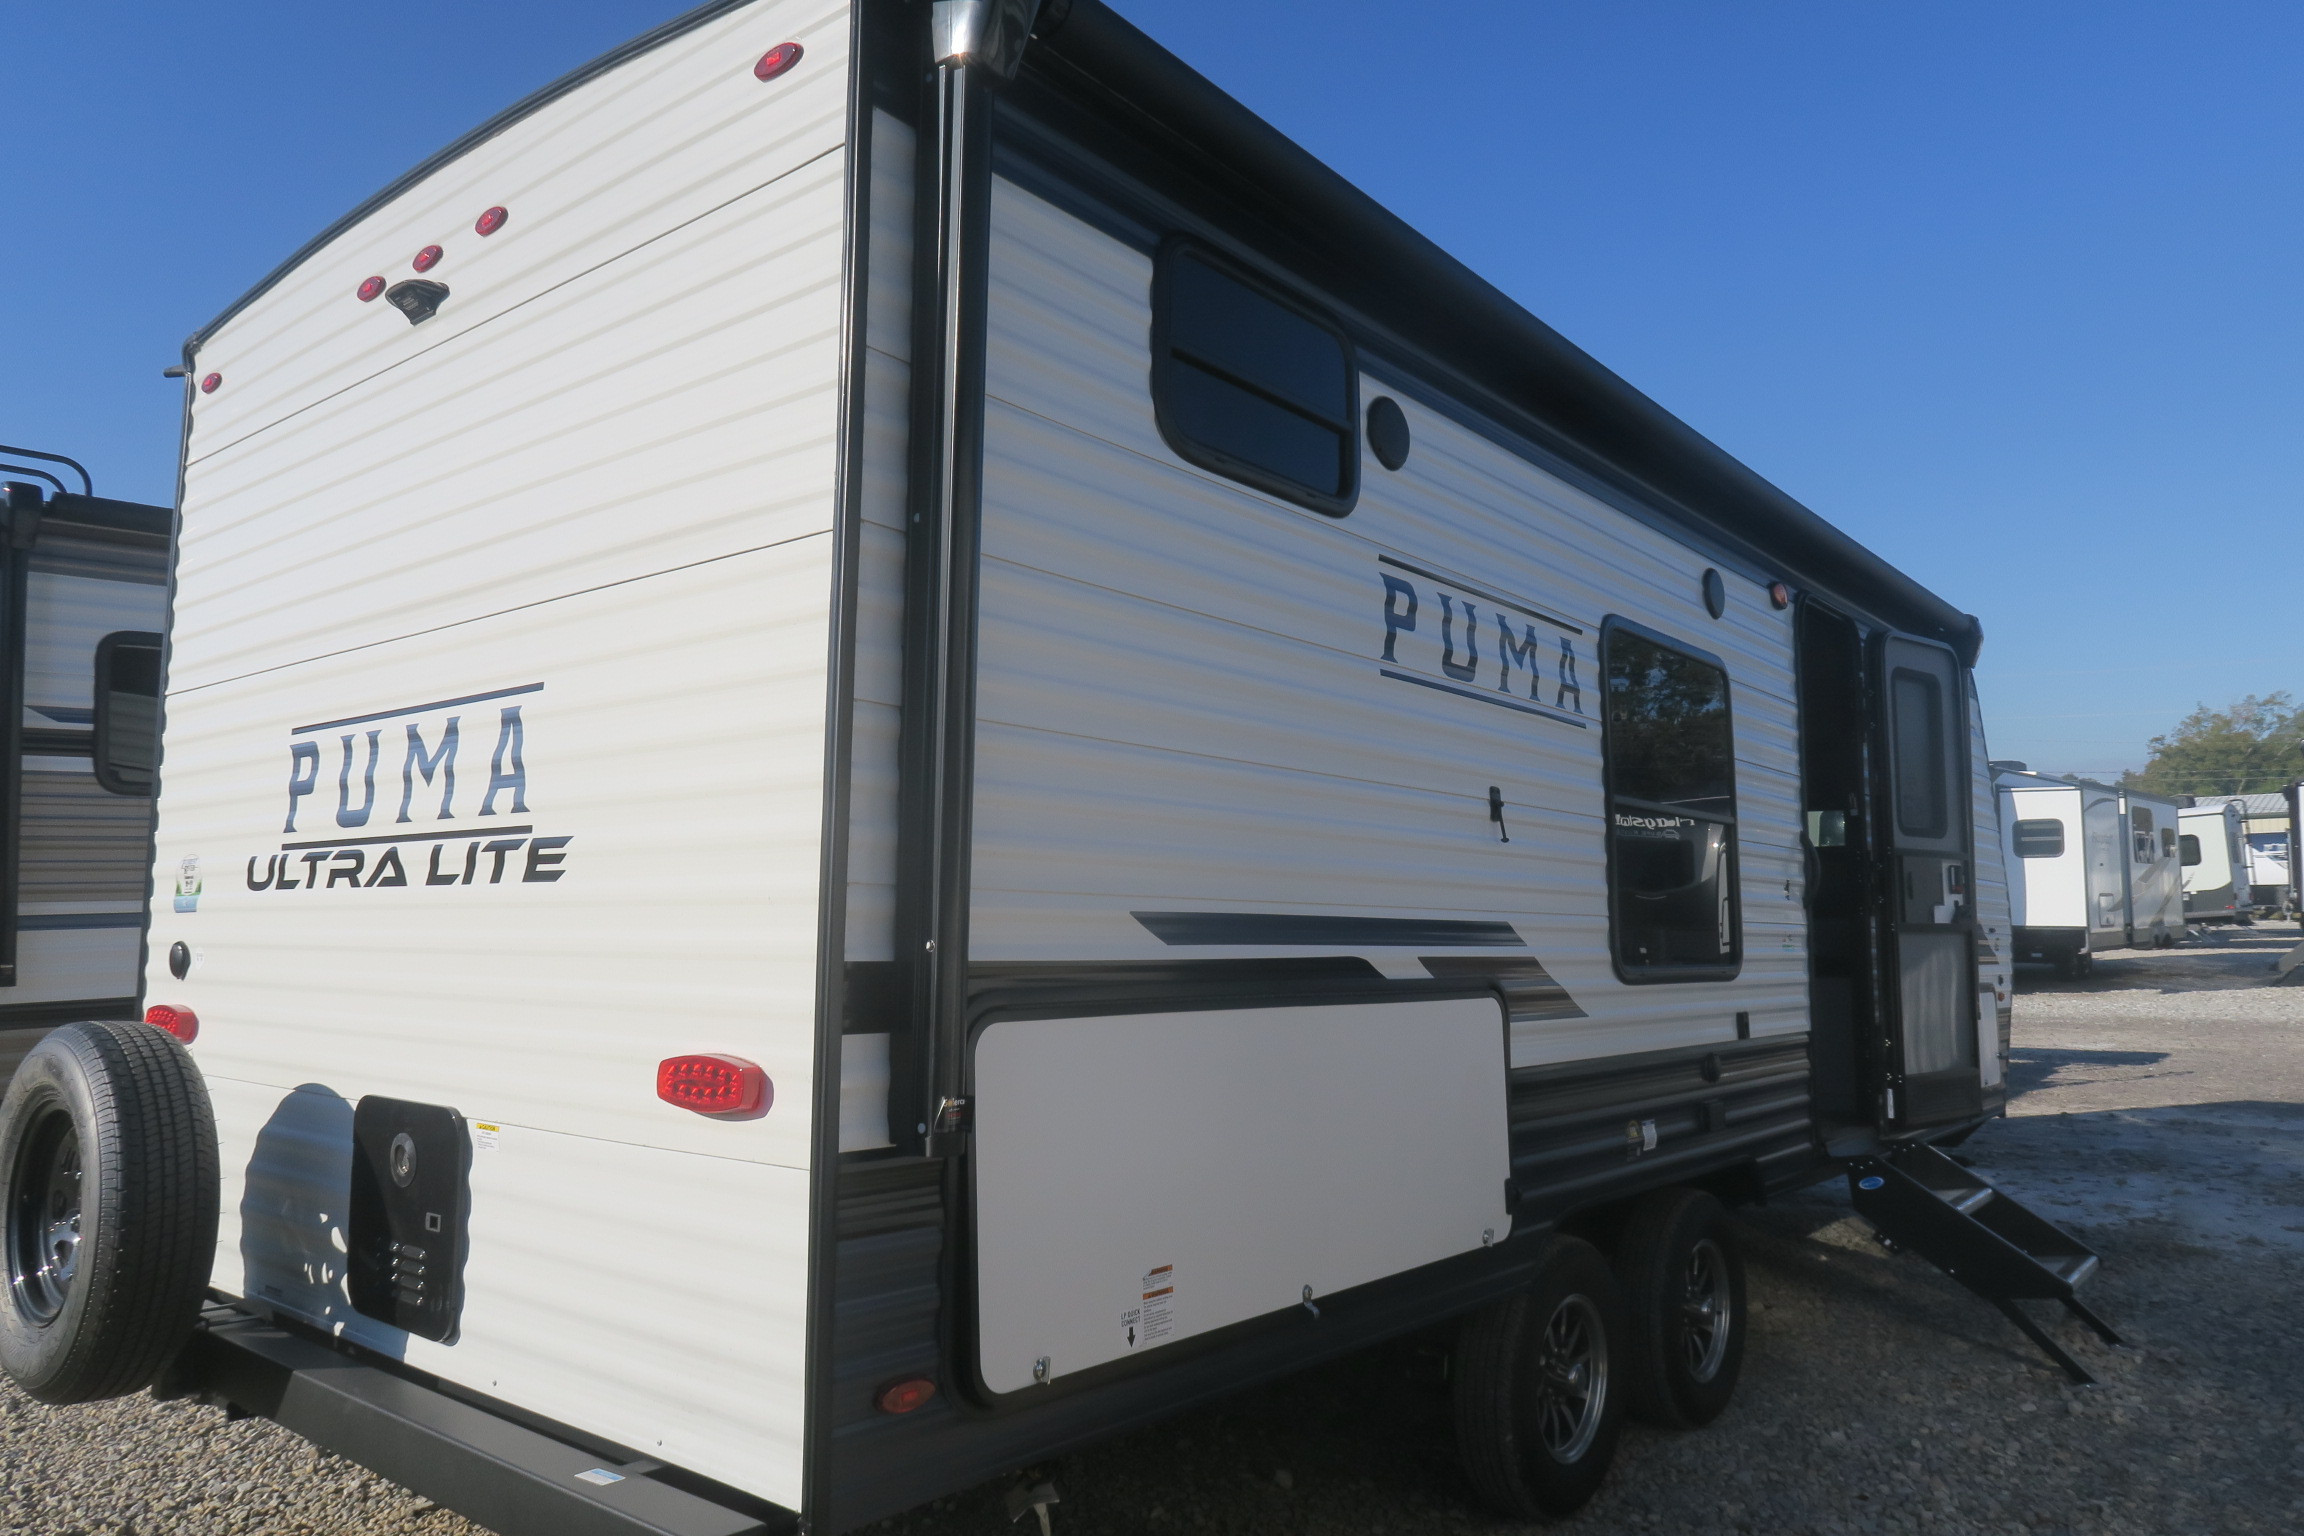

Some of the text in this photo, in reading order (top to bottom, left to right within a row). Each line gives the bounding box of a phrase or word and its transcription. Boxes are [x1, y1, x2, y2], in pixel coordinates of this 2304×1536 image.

[1379, 572, 1584, 714] PUMA
[283, 705, 531, 833] PUMA
[247, 846, 407, 891] ULTRA
[426, 836, 574, 886] LITE
[1121, 1315, 1140, 1327] CONNECT
